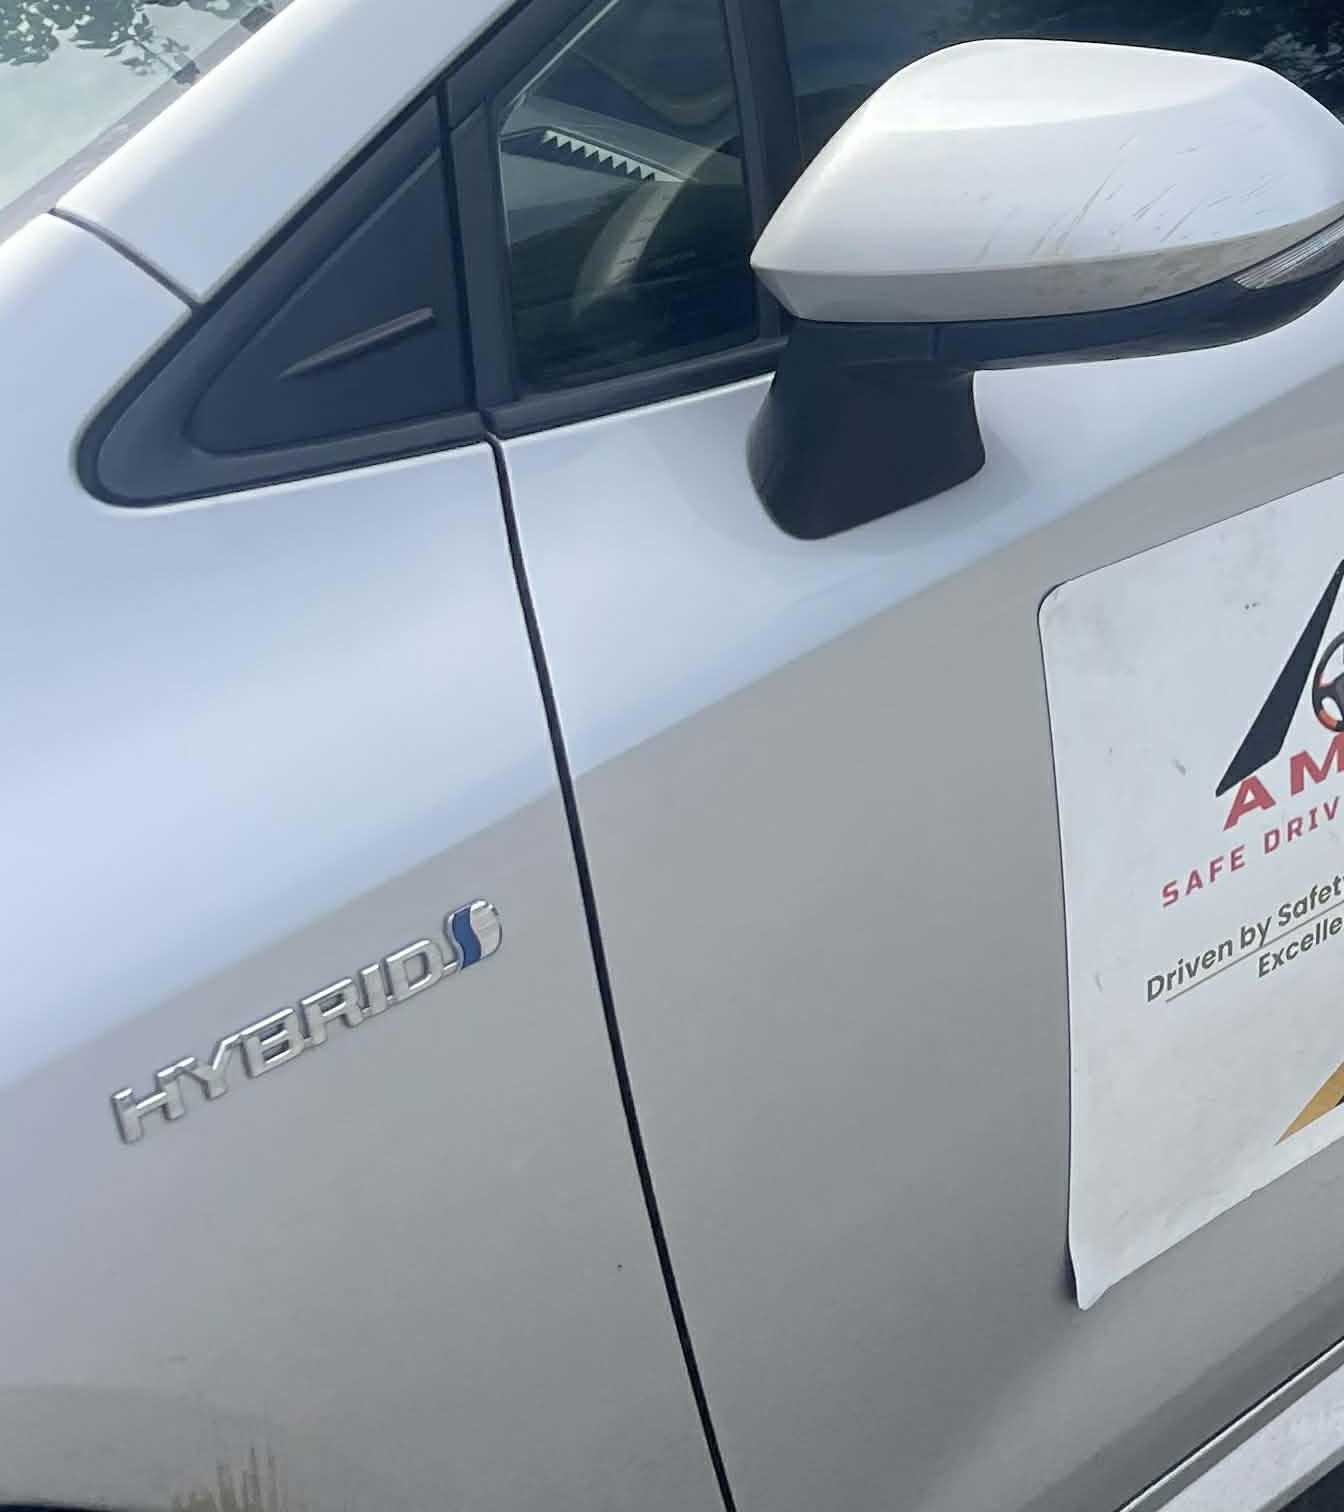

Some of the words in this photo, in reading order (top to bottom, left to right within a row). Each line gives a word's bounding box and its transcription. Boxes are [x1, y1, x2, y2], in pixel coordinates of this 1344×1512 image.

[1162, 845, 1246, 908] SAFE
[1147, 937, 1233, 1003] Driven
[1240, 916, 1271, 951] by
[112, 938, 445, 1144] HYBRID
